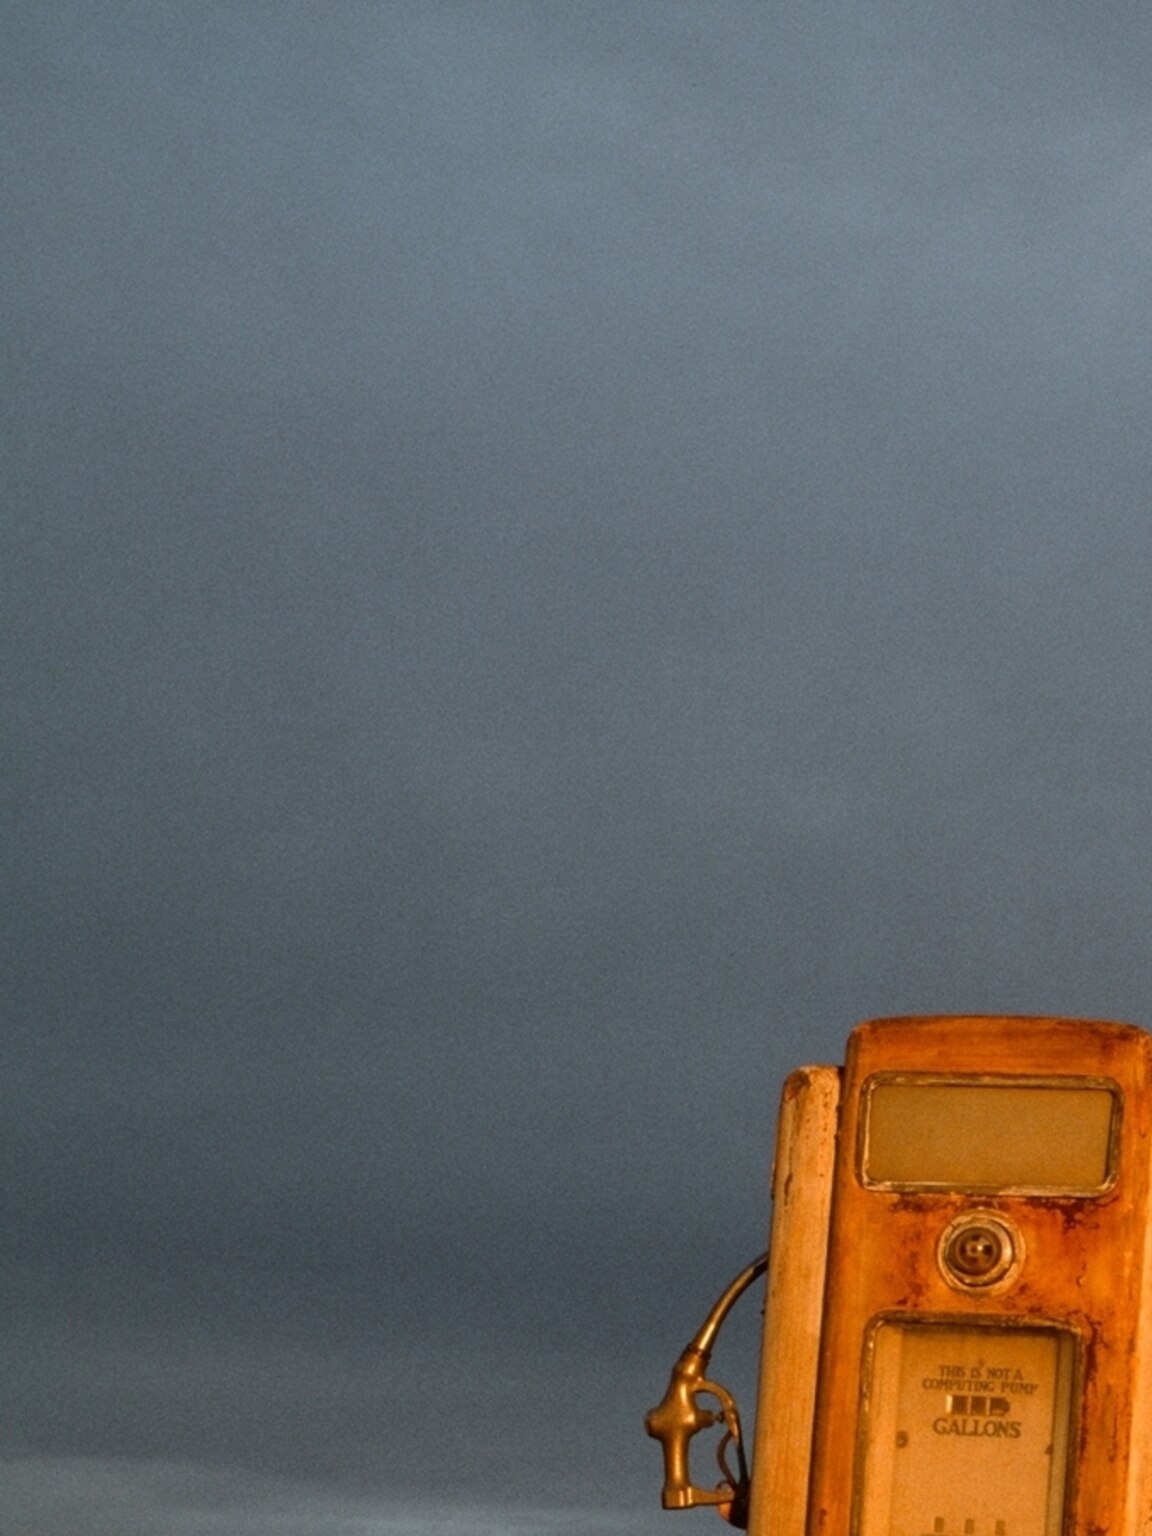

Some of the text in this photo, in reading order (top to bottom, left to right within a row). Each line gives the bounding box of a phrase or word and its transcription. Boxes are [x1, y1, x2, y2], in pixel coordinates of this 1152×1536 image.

[939, 1365, 1024, 1380] THIS IS NOT A
[922, 1378, 1039, 1395] COMPUTING PUMP
[932, 1418, 1022, 1439] GALLONS
